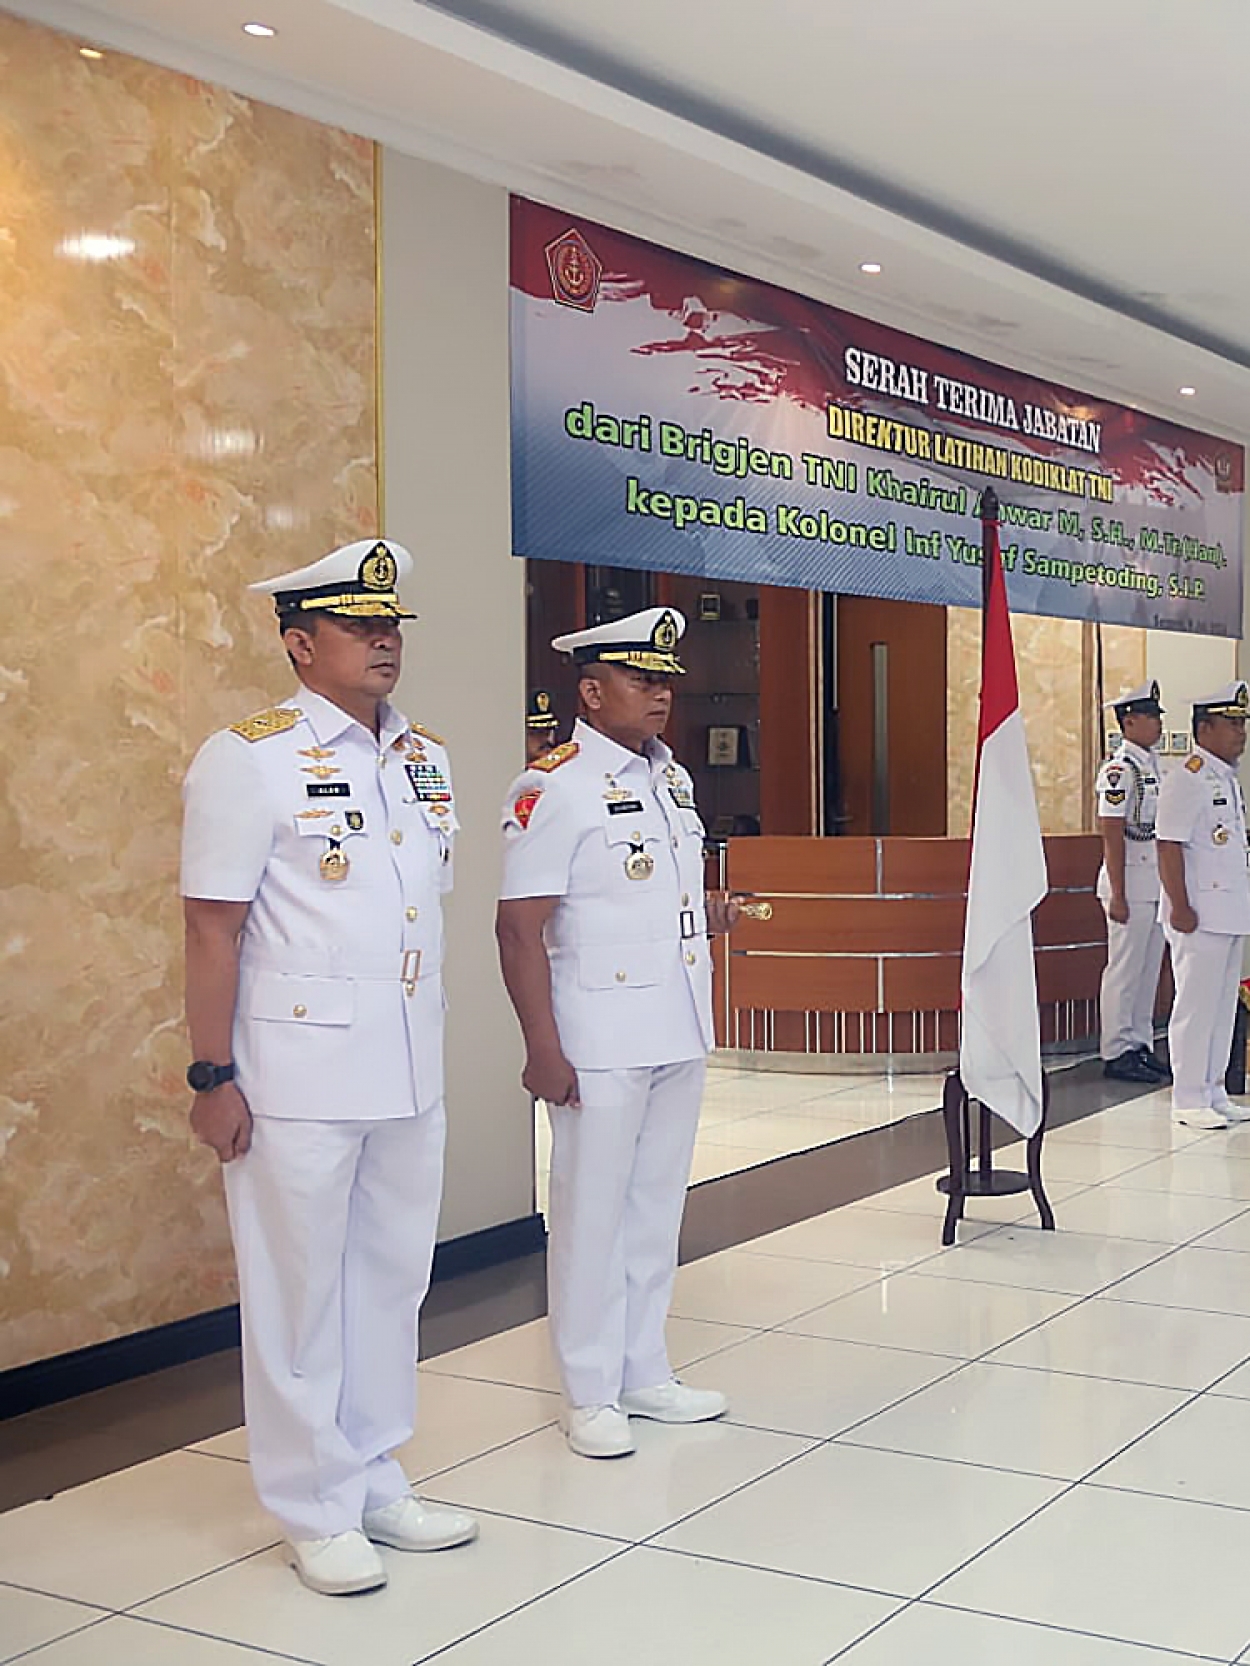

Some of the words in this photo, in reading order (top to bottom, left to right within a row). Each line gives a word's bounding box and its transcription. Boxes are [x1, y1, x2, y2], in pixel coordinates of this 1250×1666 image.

[827, 403, 931, 459] DIREKTUR
[933, 432, 1008, 479] LATIHAN
[1010, 450, 1086, 498] KODIKLAT
[1087, 471, 1113, 503] TNI
[843, 346, 929, 405] SERAH
[932, 375, 1019, 431] TERIMA
[1021, 404, 1101, 453] JABATAN
[565, 402, 651, 452] dari
[659, 421, 792, 480] Brigjen
[802, 453, 857, 493] TNI
[866, 467, 967, 516] Khairul
[626, 476, 768, 535] kepada
[776, 504, 898, 552] Kolonel
[904, 525, 943, 560] Inf
[1023, 548, 1163, 598] Sampetoding,
